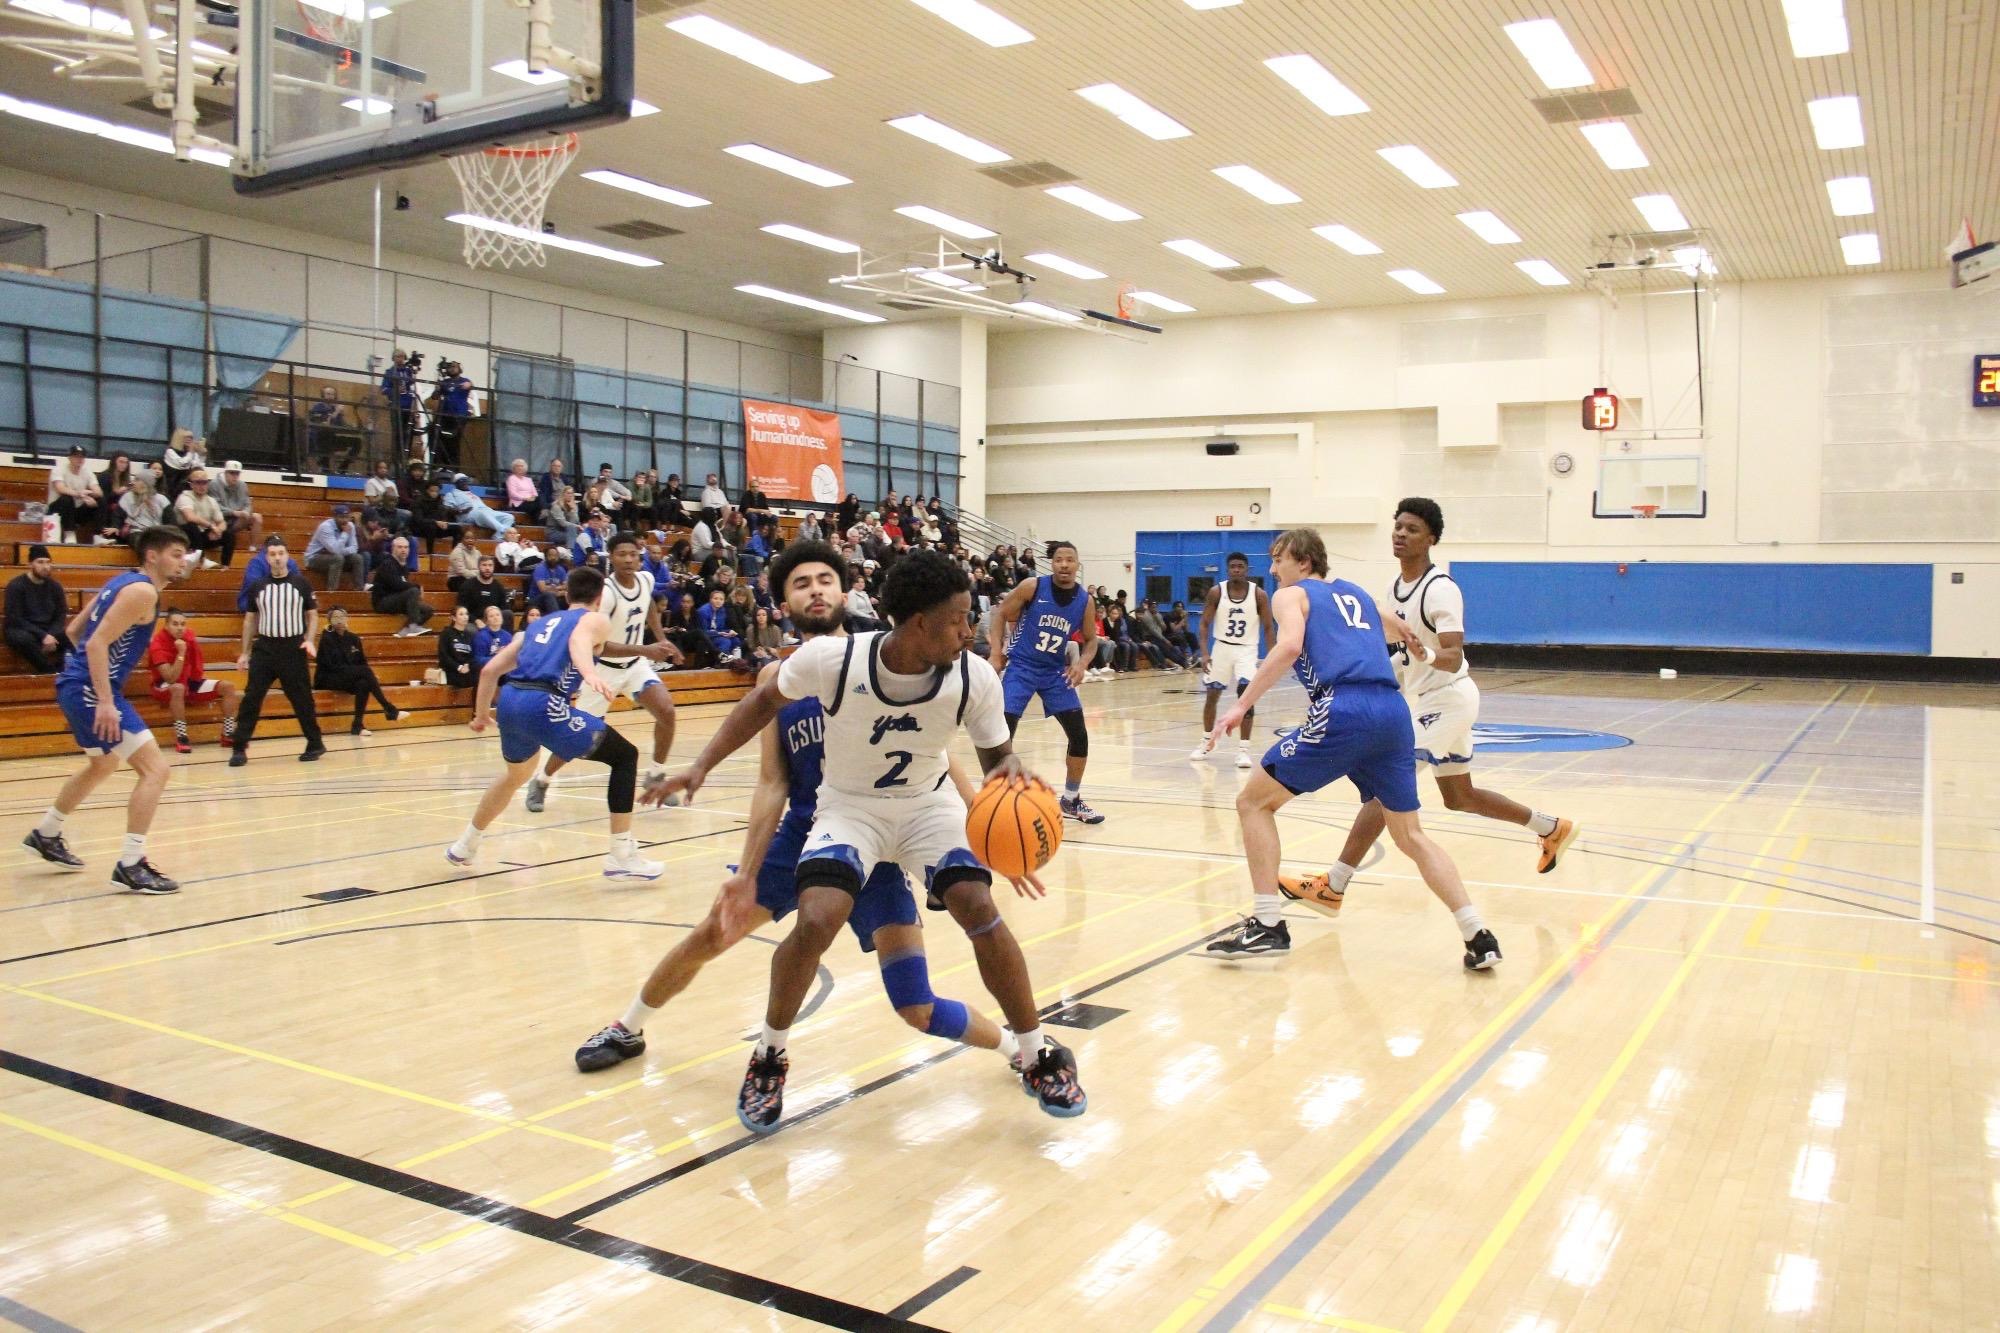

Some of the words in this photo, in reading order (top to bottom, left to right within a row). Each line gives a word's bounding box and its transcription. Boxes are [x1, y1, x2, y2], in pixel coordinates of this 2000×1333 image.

[748, 407, 787, 429] Serving
[786, 415, 801, 431] up
[1595, 406, 1614, 427] 19
[750, 426, 828, 451] humankindness.
[1332, 593, 1371, 630] 12
[534, 616, 562, 644] 3
[625, 623, 641, 645] 11
[1038, 614, 1072, 635] CSUSM
[1225, 619, 1247, 638] 33
[1035, 631, 1063, 653] 32
[788, 715, 823, 754] CSU
[874, 750, 913, 788] 2
